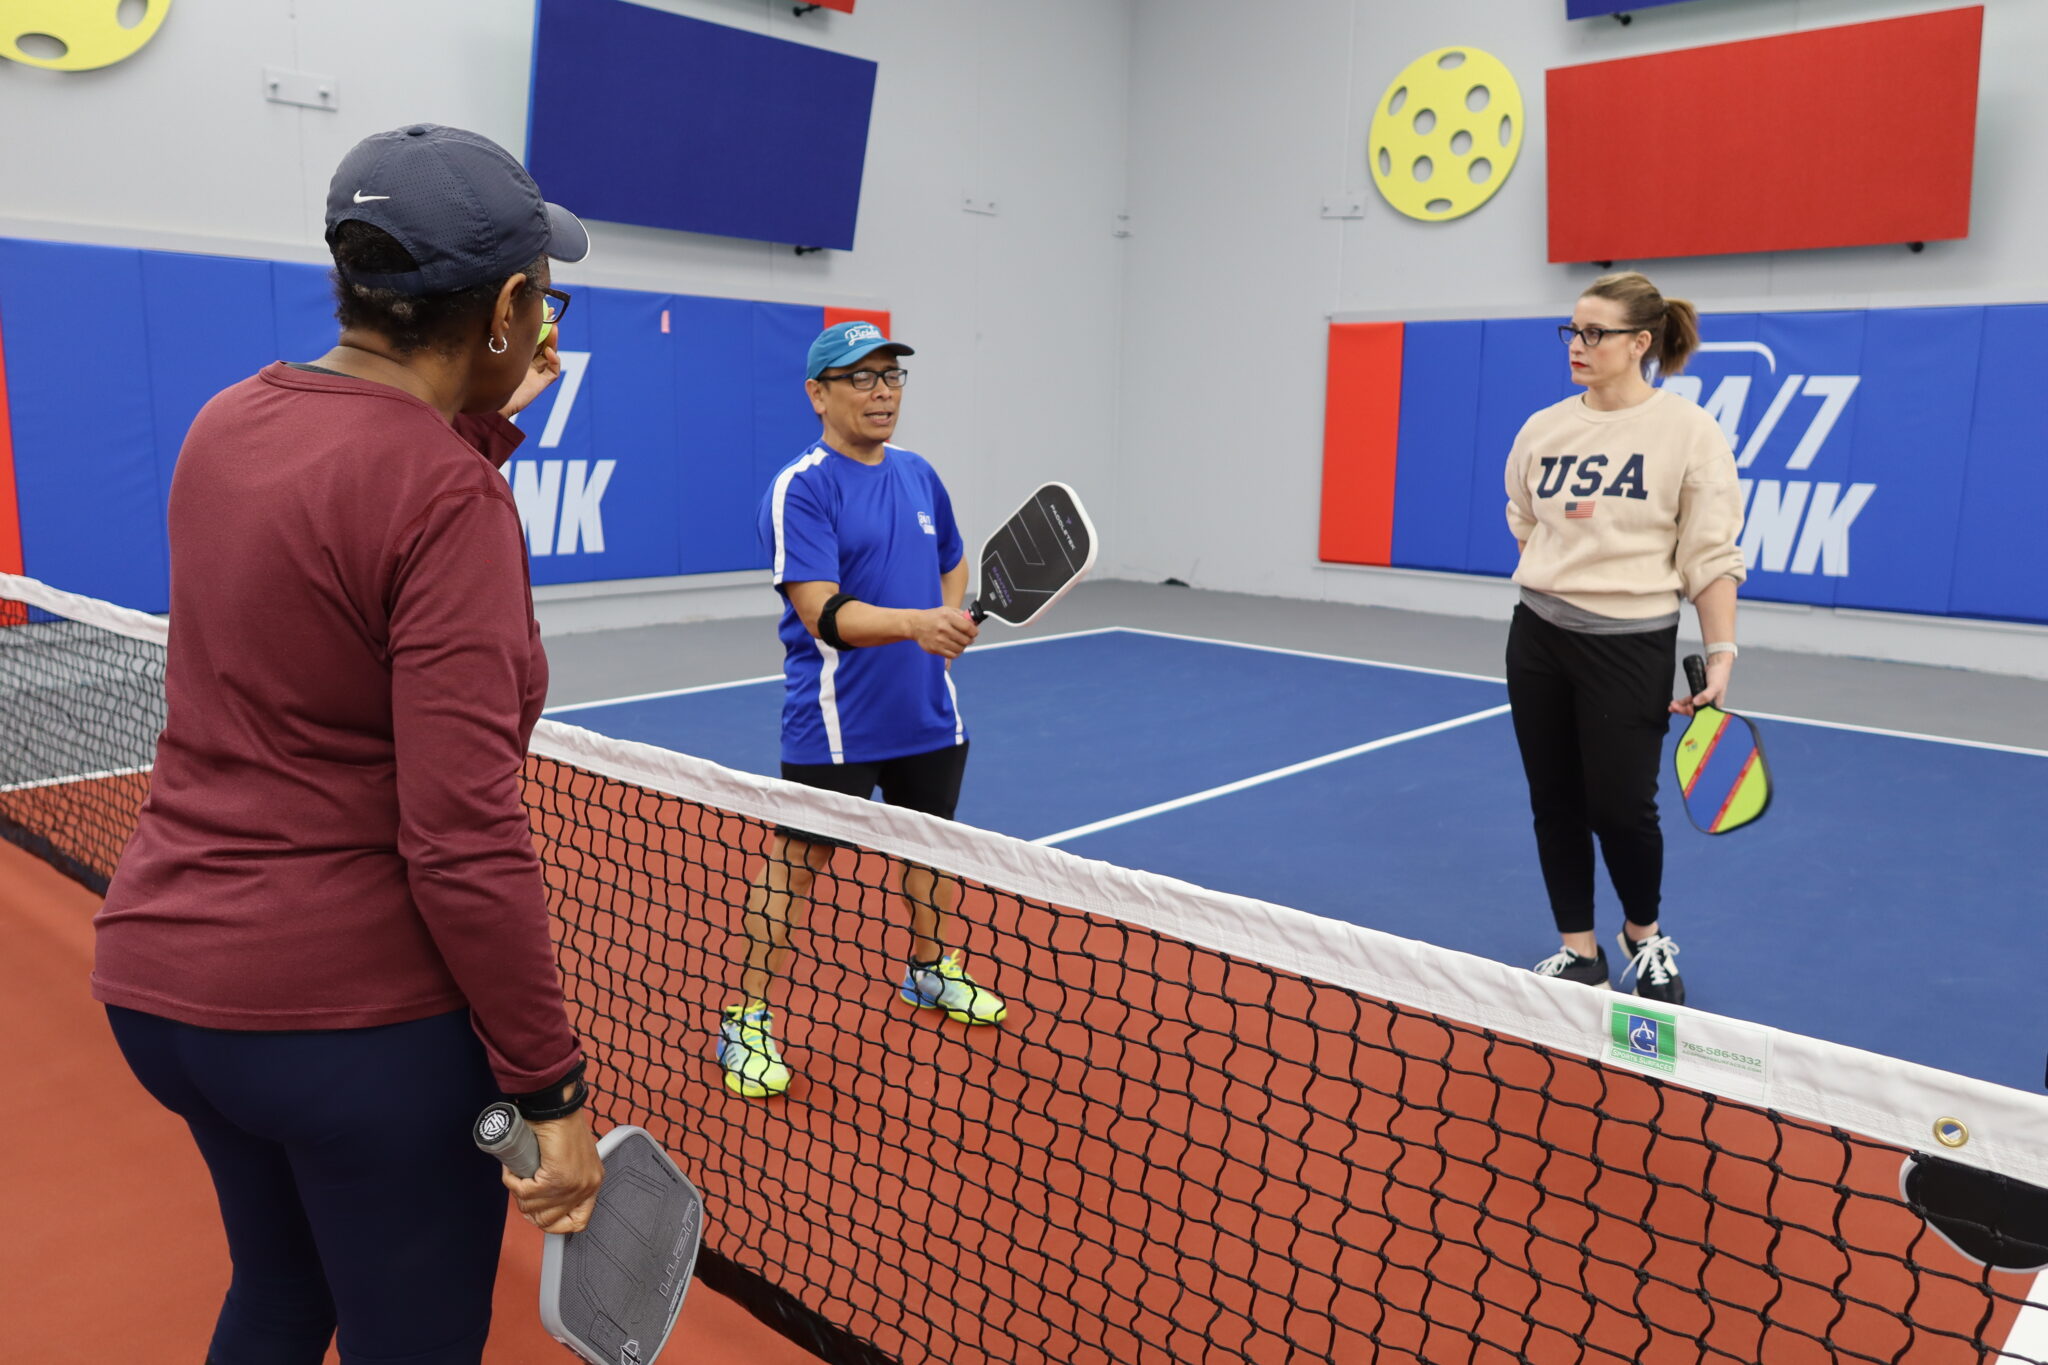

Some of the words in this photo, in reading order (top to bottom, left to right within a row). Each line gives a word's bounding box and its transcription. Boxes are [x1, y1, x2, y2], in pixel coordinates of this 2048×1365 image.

[1536, 452, 1648, 500] USA
[498, 459, 617, 557] NK
[1050, 504, 1076, 551] PADDLETEK
[1739, 479, 1877, 577] NK
[1612, 1049, 1638, 1063] SPORTS
[1639, 1056, 1674, 1072] SURFACES
[1681, 1040, 1762, 1067] 765-586-5332
